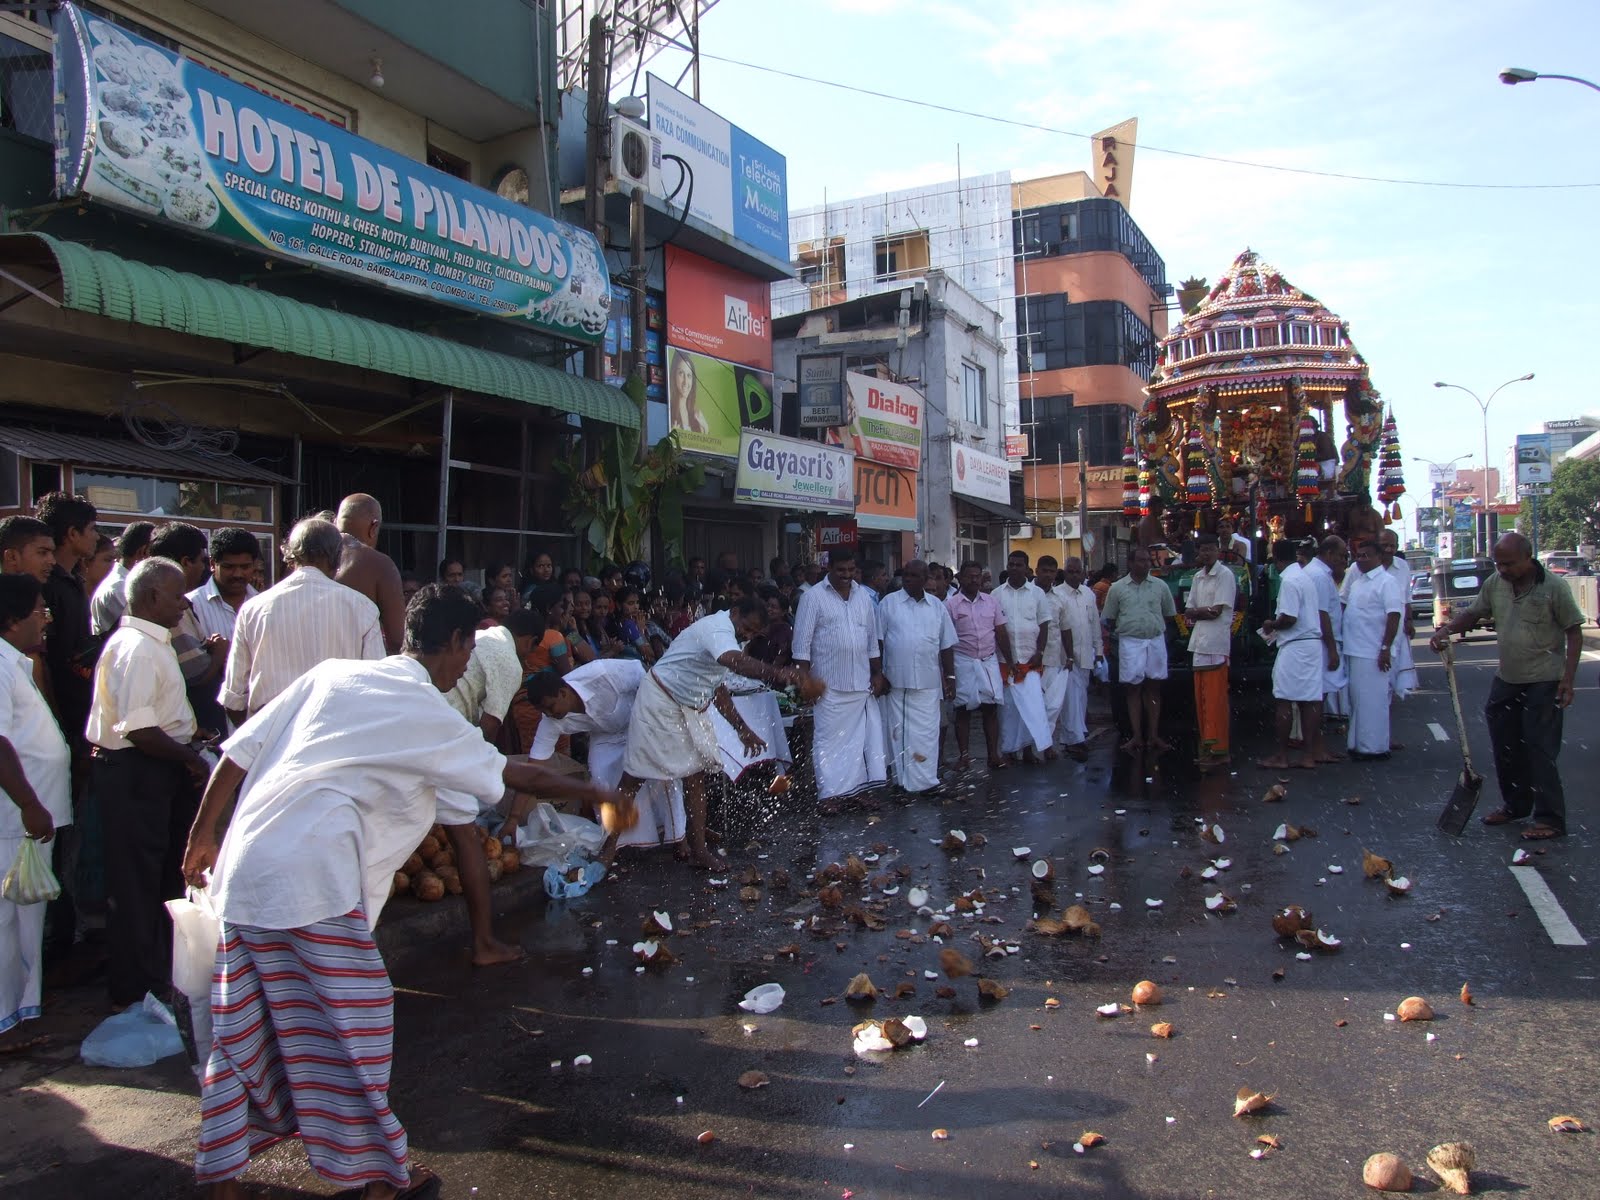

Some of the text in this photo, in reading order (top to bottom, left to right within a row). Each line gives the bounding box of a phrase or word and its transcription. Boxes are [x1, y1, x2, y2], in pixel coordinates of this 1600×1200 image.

[656, 113, 674, 137] RAZA
[676, 125, 729, 168] COMMUNICATION
[198, 88, 343, 200] HOTEL
[350, 153, 402, 223] DE
[408, 176, 567, 279] PILAWOOS
[739, 154, 781, 195] Telecom
[754, 160, 780, 182] Sri Lanka
[745, 185, 779, 222] Mobitel
[224, 172, 267, 200] SPECIAL
[270, 188, 301, 211] CHEES
[304, 200, 341, 225] KOTTHU
[343, 214, 350, 228] &
[353, 218, 379, 238] CHEES
[381, 228, 408, 250] ROTTY,
[410, 238, 450, 263] BURIYANI,
[453, 251, 474, 268] FRIED
[476, 260, 493, 276] RICE,
[495, 266, 523, 284] CHICKEN
[308, 243, 338, 262] GALLE
[430, 281, 466, 298] COLOMBO
[312, 223, 495, 291] HOPPERS, STRING HOPPERS, BOMBEY SWEETS
[684, 328, 723, 345] Communication
[727, 305, 764, 337] Airtel
[806, 367, 832, 378] Suntel
[868, 387, 918, 425] Dialog
[747, 438, 833, 480] Gayasri's
[792, 479, 833, 496] Jewellery
[823, 530, 854, 543] Airtel
